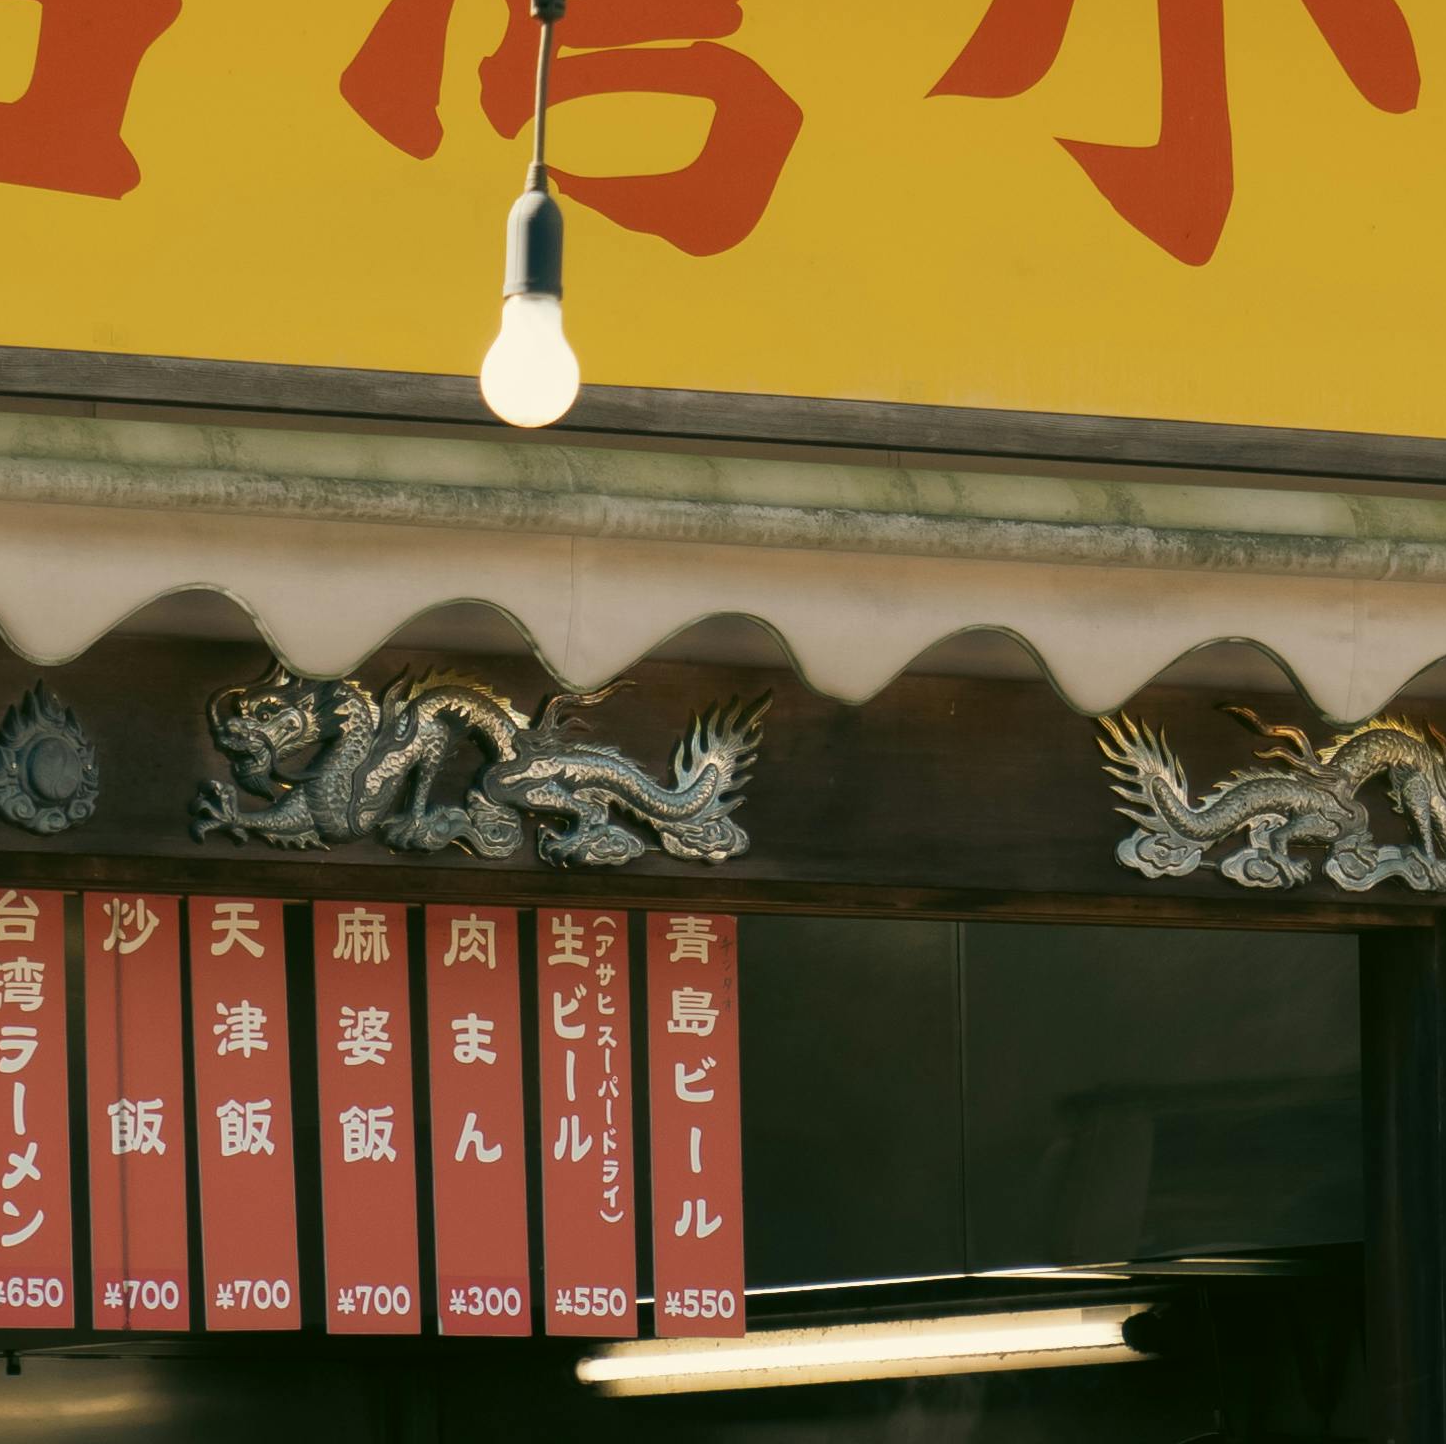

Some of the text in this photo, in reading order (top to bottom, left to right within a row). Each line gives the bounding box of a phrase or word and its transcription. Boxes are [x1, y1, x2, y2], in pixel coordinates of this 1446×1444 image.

[103, 897, 166, 1156] 炒飯
[211, 902, 275, 1157] 天津飯
[333, 907, 397, 1163] 麻婆飯
[443, 913, 502, 1164] 肉まん
[548, 914, 592, 1163] 生ビール
[665, 916, 723, 1239] 青島ビール
[103, 1280, 180, 1311] ¥700
[215, 1279, 291, 1310] ¥700
[337, 1285, 411, 1316] ¥700
[448, 1286, 522, 1317] ¥300
[555, 1287, 627, 1318] ¥550
[664, 1288, 736, 1319] ¥550
